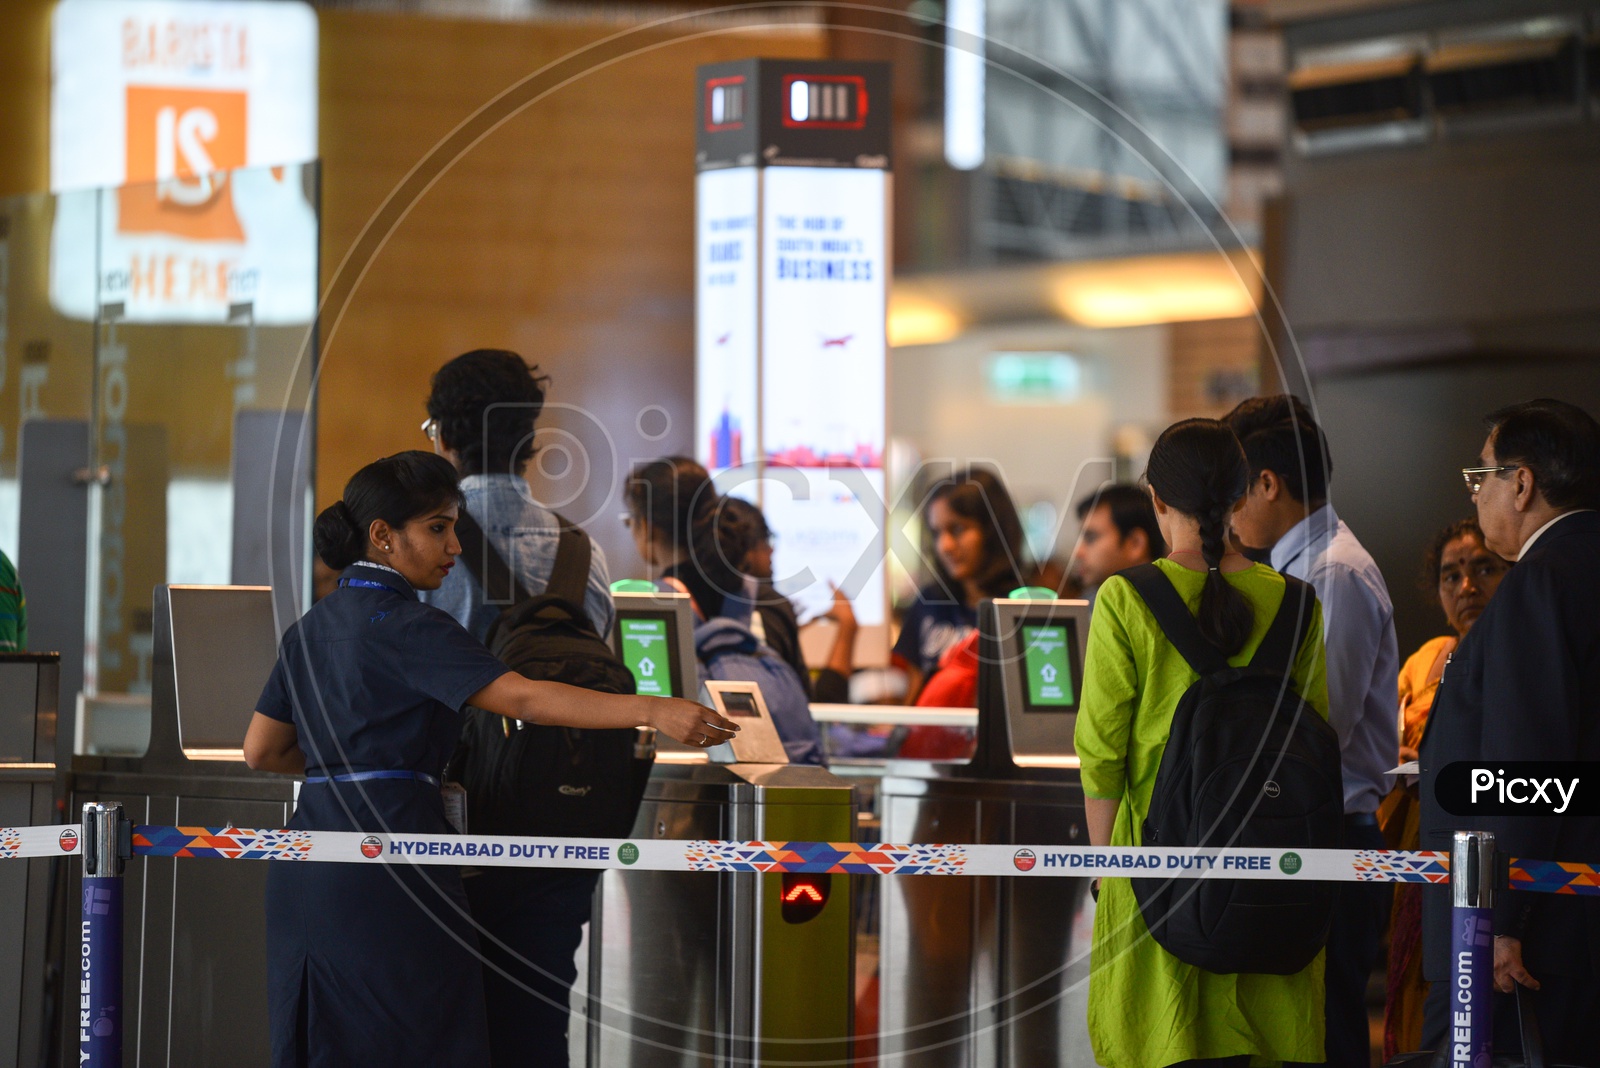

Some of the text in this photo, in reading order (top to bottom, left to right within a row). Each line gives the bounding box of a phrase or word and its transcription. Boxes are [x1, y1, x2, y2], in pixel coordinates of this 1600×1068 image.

[120, 18, 249, 72] BARISTA
[156, 105, 224, 206] IS
[777, 215, 796, 230] THE
[777, 238, 814, 252] SOUTH
[130, 254, 239, 303] HERE
[777, 257, 873, 281] BUSINESS
[389, 841, 504, 857] HYDERABAD
[509, 844, 559, 859] DUTY
[564, 846, 610, 860] FREE
[1043, 853, 1162, 869] HYDERABAD
[1166, 855, 1218, 869] DUTY
[1223, 856, 1272, 870] FREE
[80, 921, 91, 1042] FREE.com
[1453, 951, 1473, 1068] FREE.com
